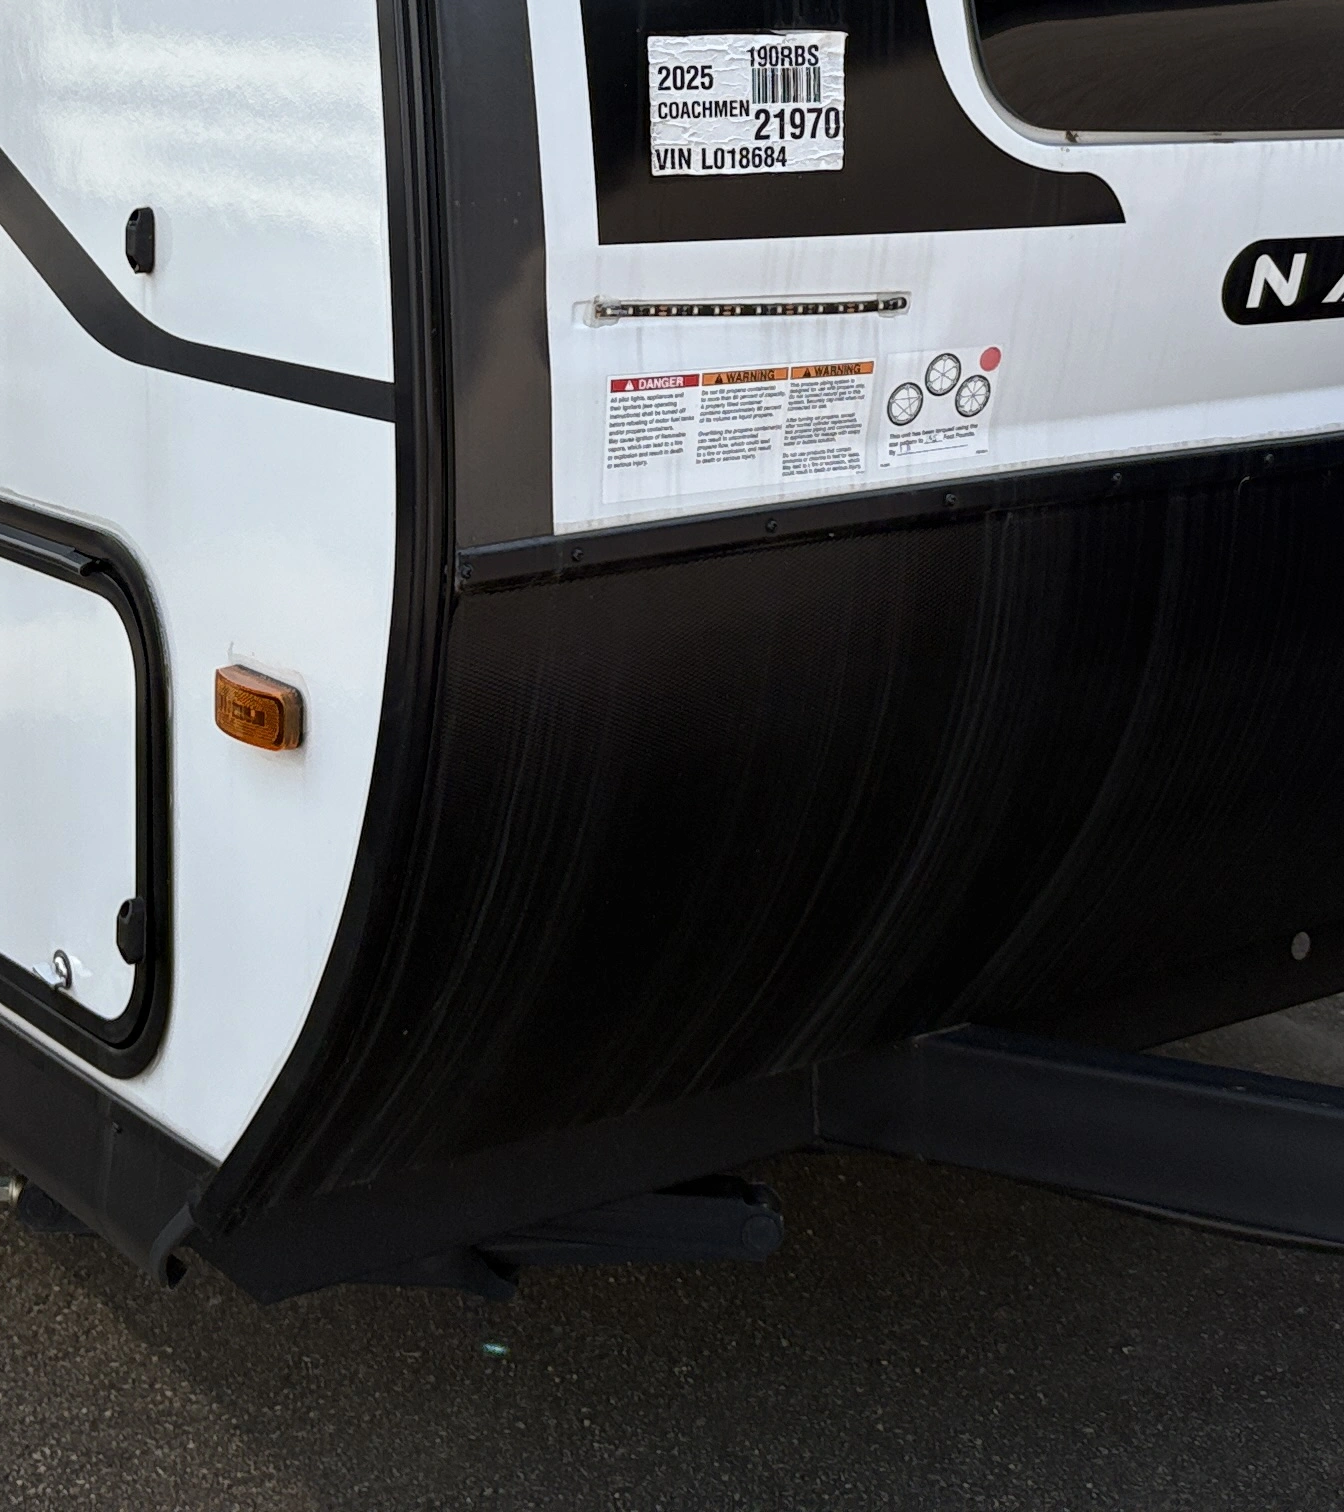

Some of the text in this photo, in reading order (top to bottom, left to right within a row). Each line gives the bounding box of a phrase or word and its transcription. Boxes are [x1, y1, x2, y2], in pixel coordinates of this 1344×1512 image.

[747, 44, 820, 68] 190RBS
[657, 65, 714, 91] 2025
[657, 99, 751, 120] COACHMEN
[754, 106, 841, 140] 21970
[654, 146, 788, 170] VIN L018684
[726, 369, 775, 383] WARNING
[814, 363, 861, 377] WARNING
[638, 376, 684, 390] DANGER
